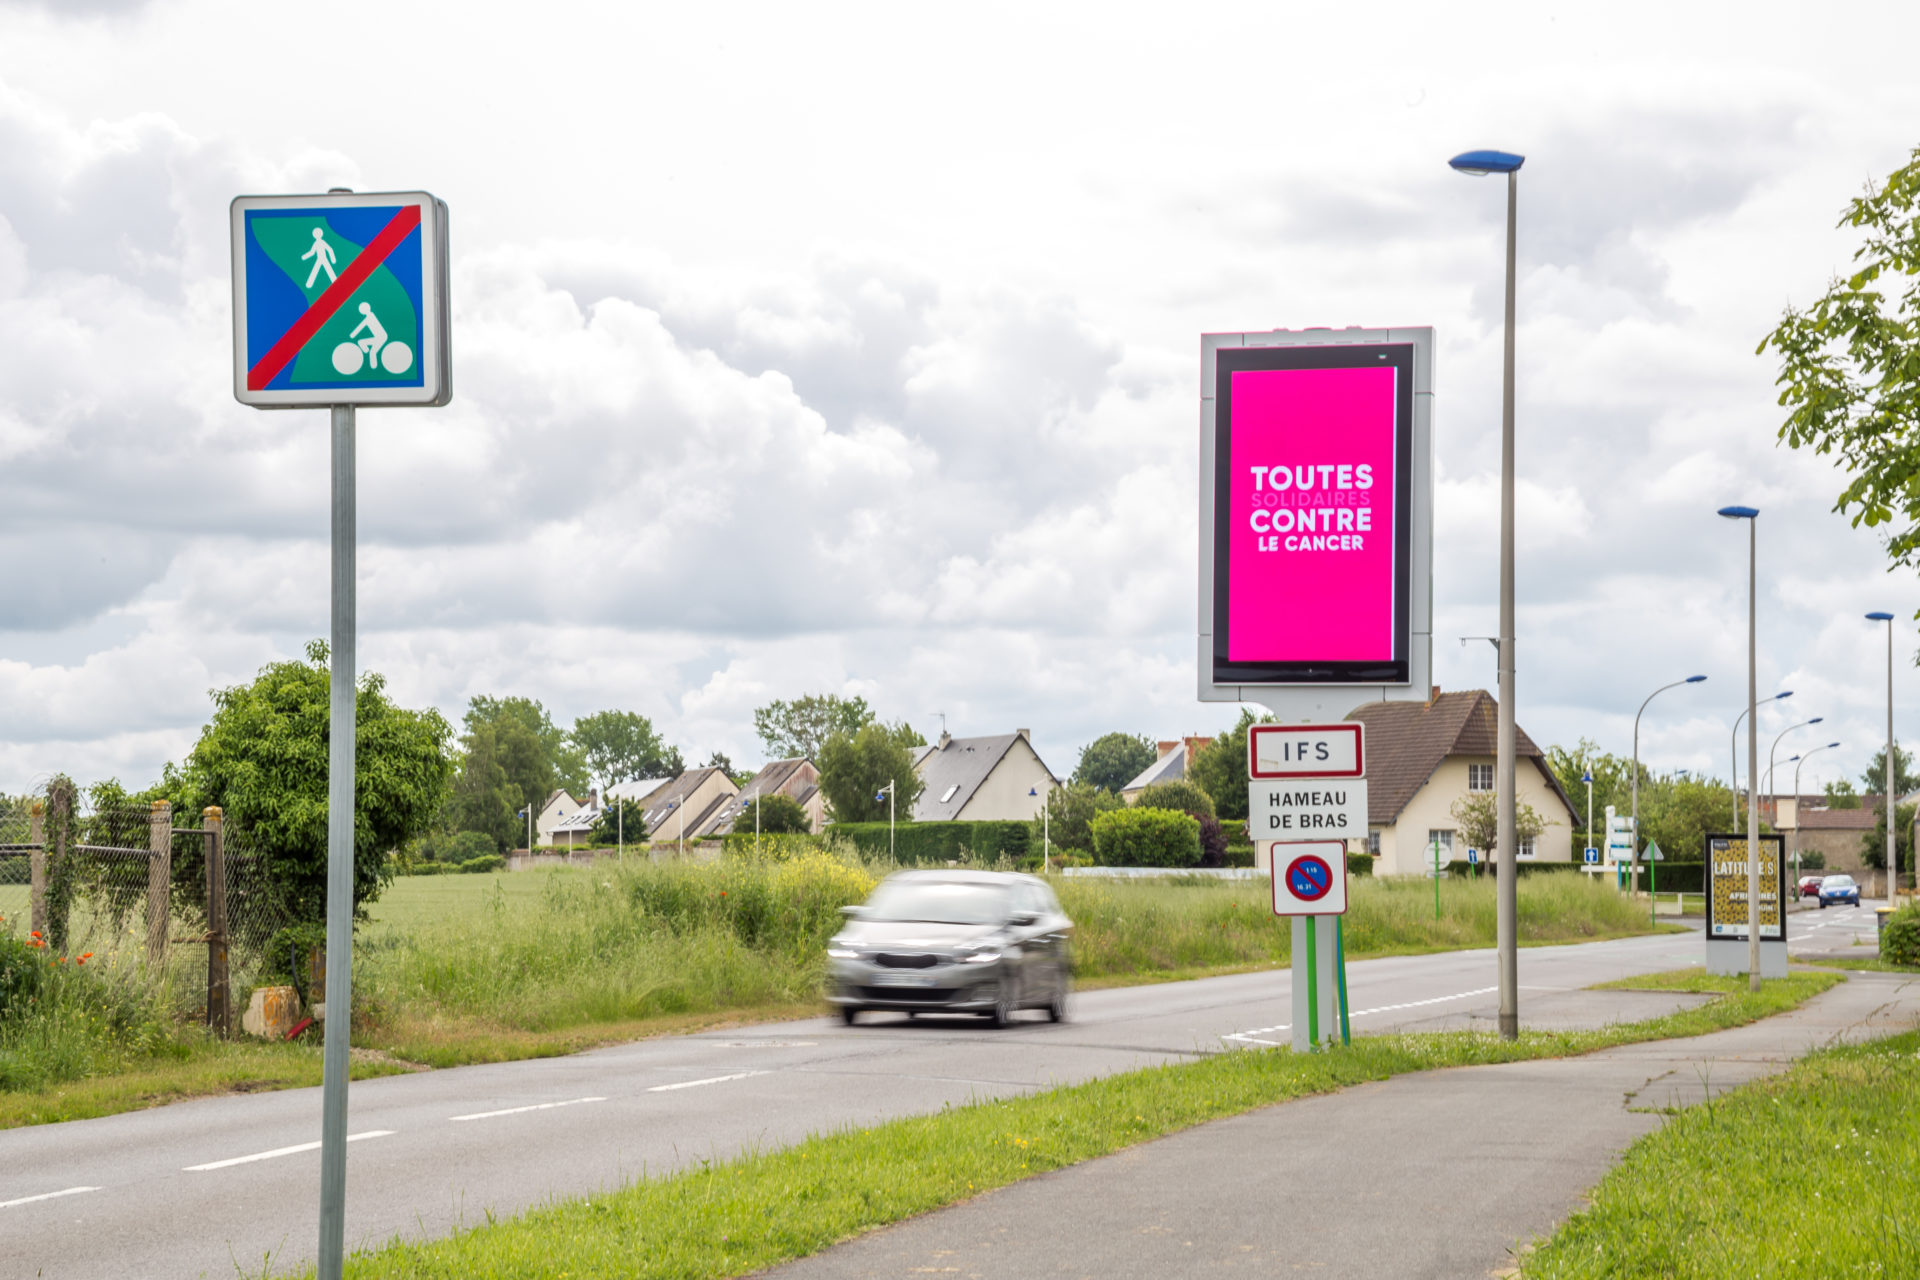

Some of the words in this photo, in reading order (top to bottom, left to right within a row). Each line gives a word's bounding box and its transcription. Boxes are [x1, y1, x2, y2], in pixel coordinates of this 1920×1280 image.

[1250, 464, 1374, 491] TOUTES
[1251, 492, 1370, 507] SOLIDAIRES
[1249, 508, 1372, 533] CONTRE
[1258, 536, 1279, 552] LE
[1284, 535, 1364, 552] CANCER
[1284, 741, 1330, 761] IFS
[1269, 791, 1347, 807] HAMEAU
[1269, 814, 1292, 829] DE
[1300, 813, 1348, 829] BRAS
